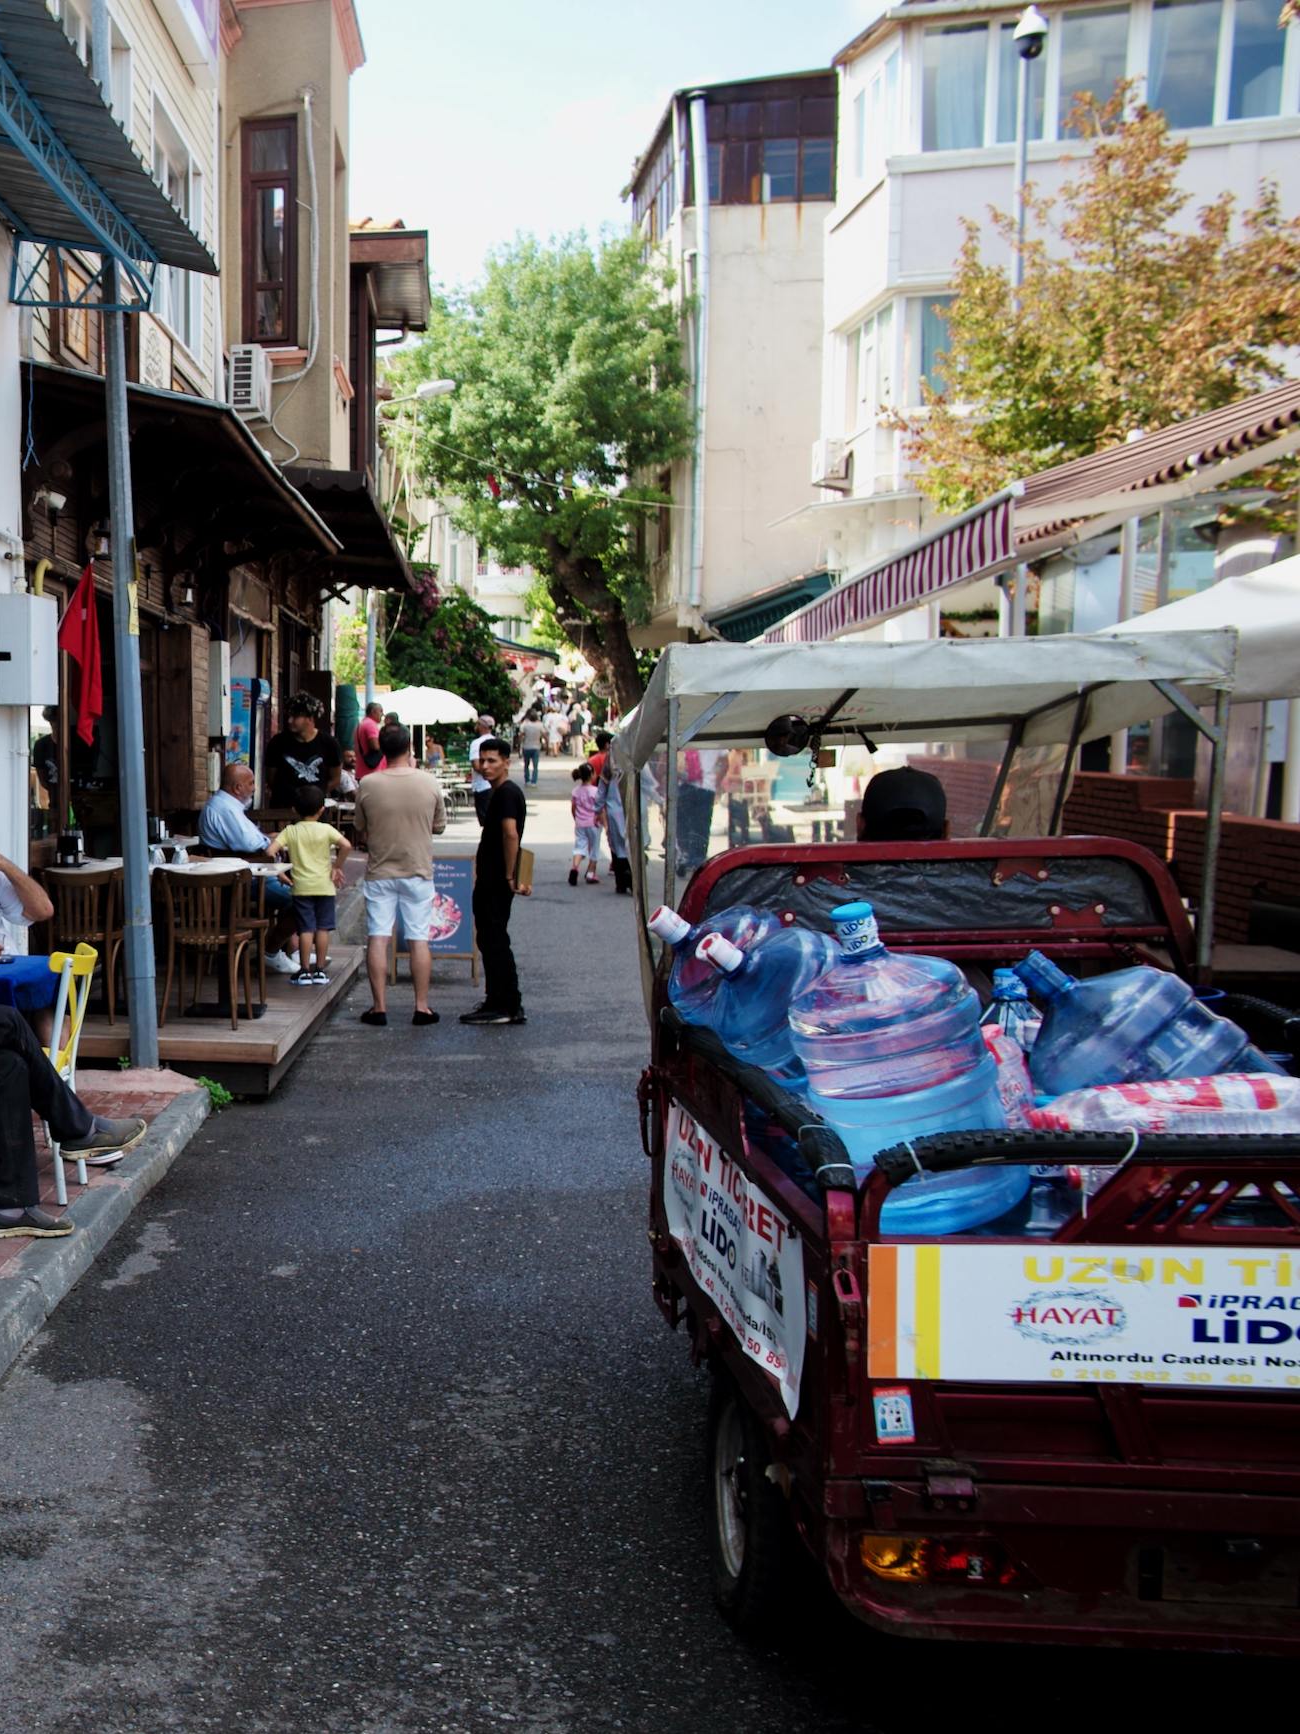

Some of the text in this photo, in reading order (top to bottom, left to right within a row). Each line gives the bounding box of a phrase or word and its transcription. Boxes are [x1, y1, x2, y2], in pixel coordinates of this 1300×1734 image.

[701, 1208, 736, 1270] LİDO
[1023, 1256, 1204, 1285] UZUN
[705, 1277, 715, 1292] 40
[747, 1337, 761, 1355] 50
[1012, 1307, 1122, 1326] HAYAT
[1050, 1350, 1154, 1363] Altınordu
[1161, 1353, 1256, 1367] Caddesi
[1050, 1368, 1064, 1379] 0
[1075, 1368, 1117, 1380] 216
[1128, 1370, 1171, 1382] 382
[1185, 1371, 1211, 1383] 30
[1225, 1373, 1253, 1384] 40
